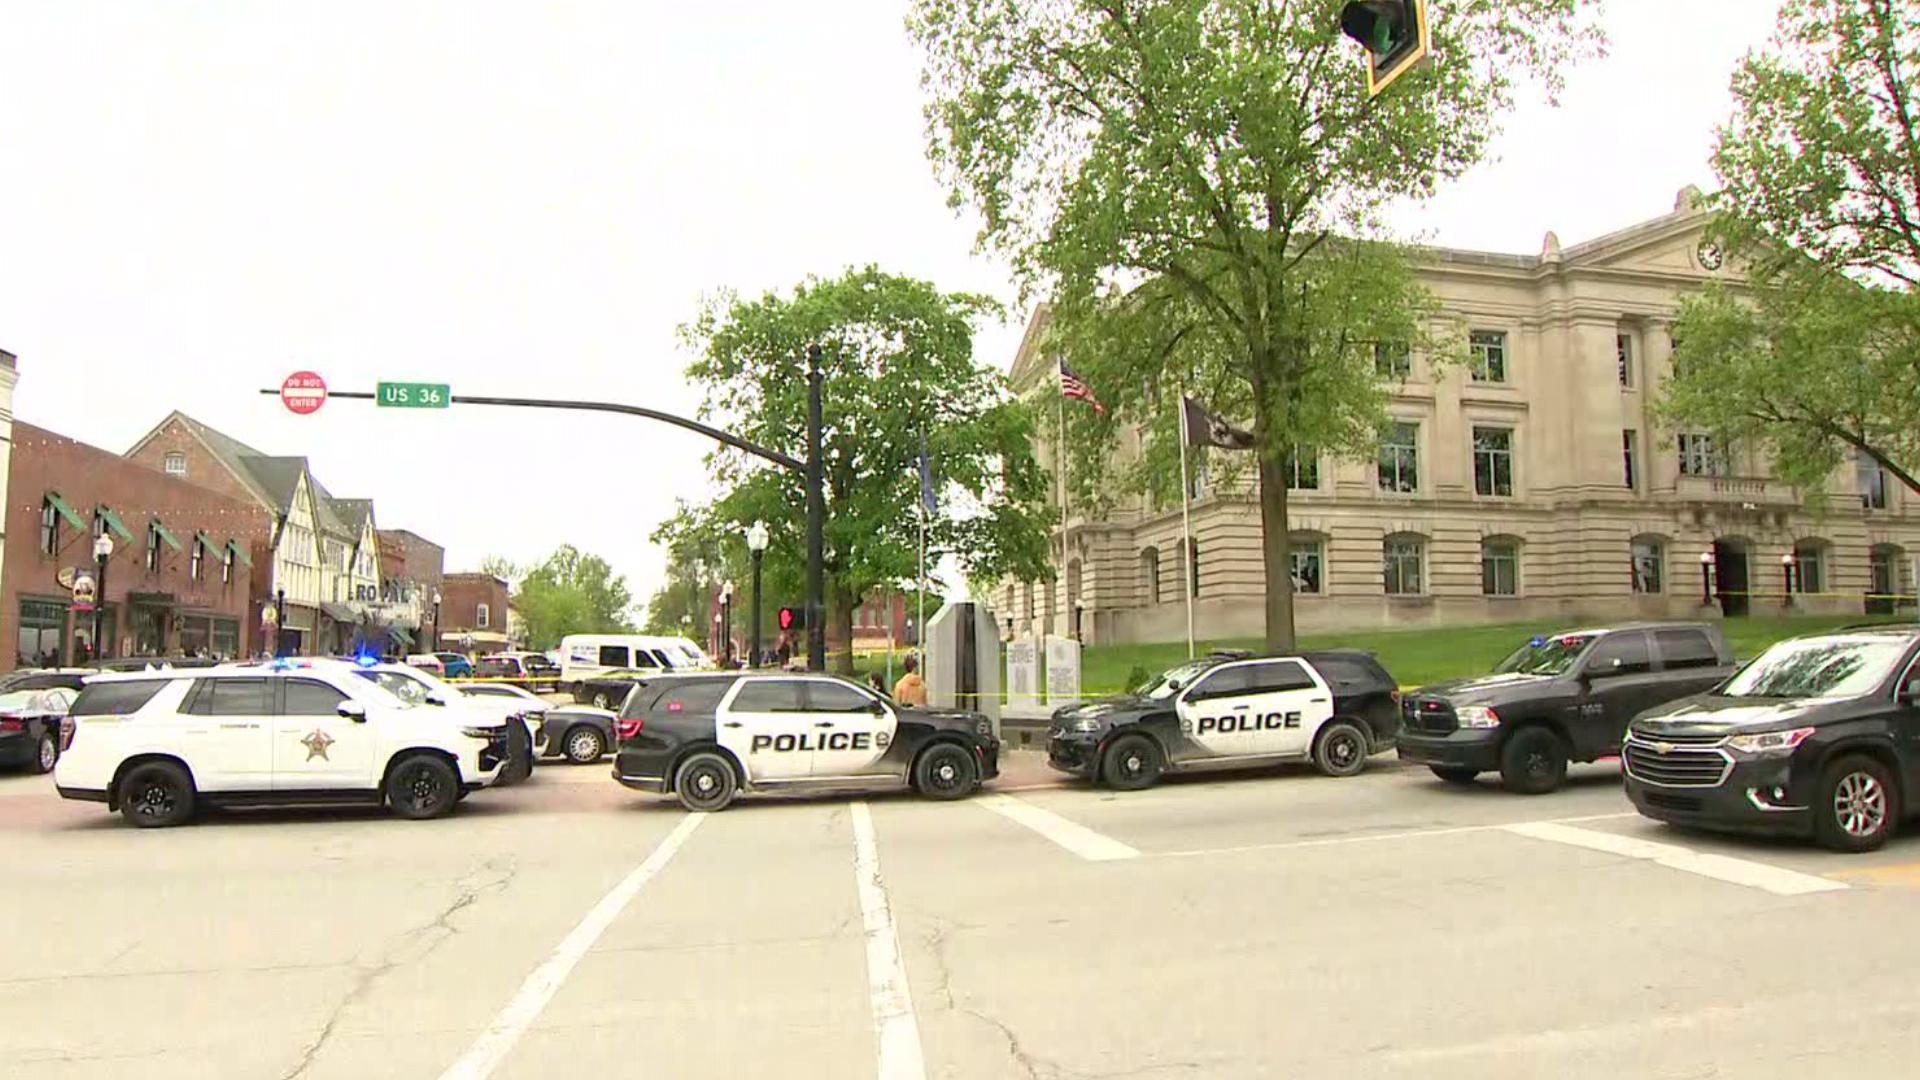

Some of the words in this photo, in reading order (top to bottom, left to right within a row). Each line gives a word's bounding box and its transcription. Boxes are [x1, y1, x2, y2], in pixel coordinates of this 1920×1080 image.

[287, 378, 300, 387] DO
[303, 378, 321, 388] NOT
[289, 398, 318, 409] ENTER
[386, 387, 408, 402] US
[419, 389, 440, 404] 36
[1197, 711, 1302, 735] POLICE
[750, 732, 871, 755] POLICE
